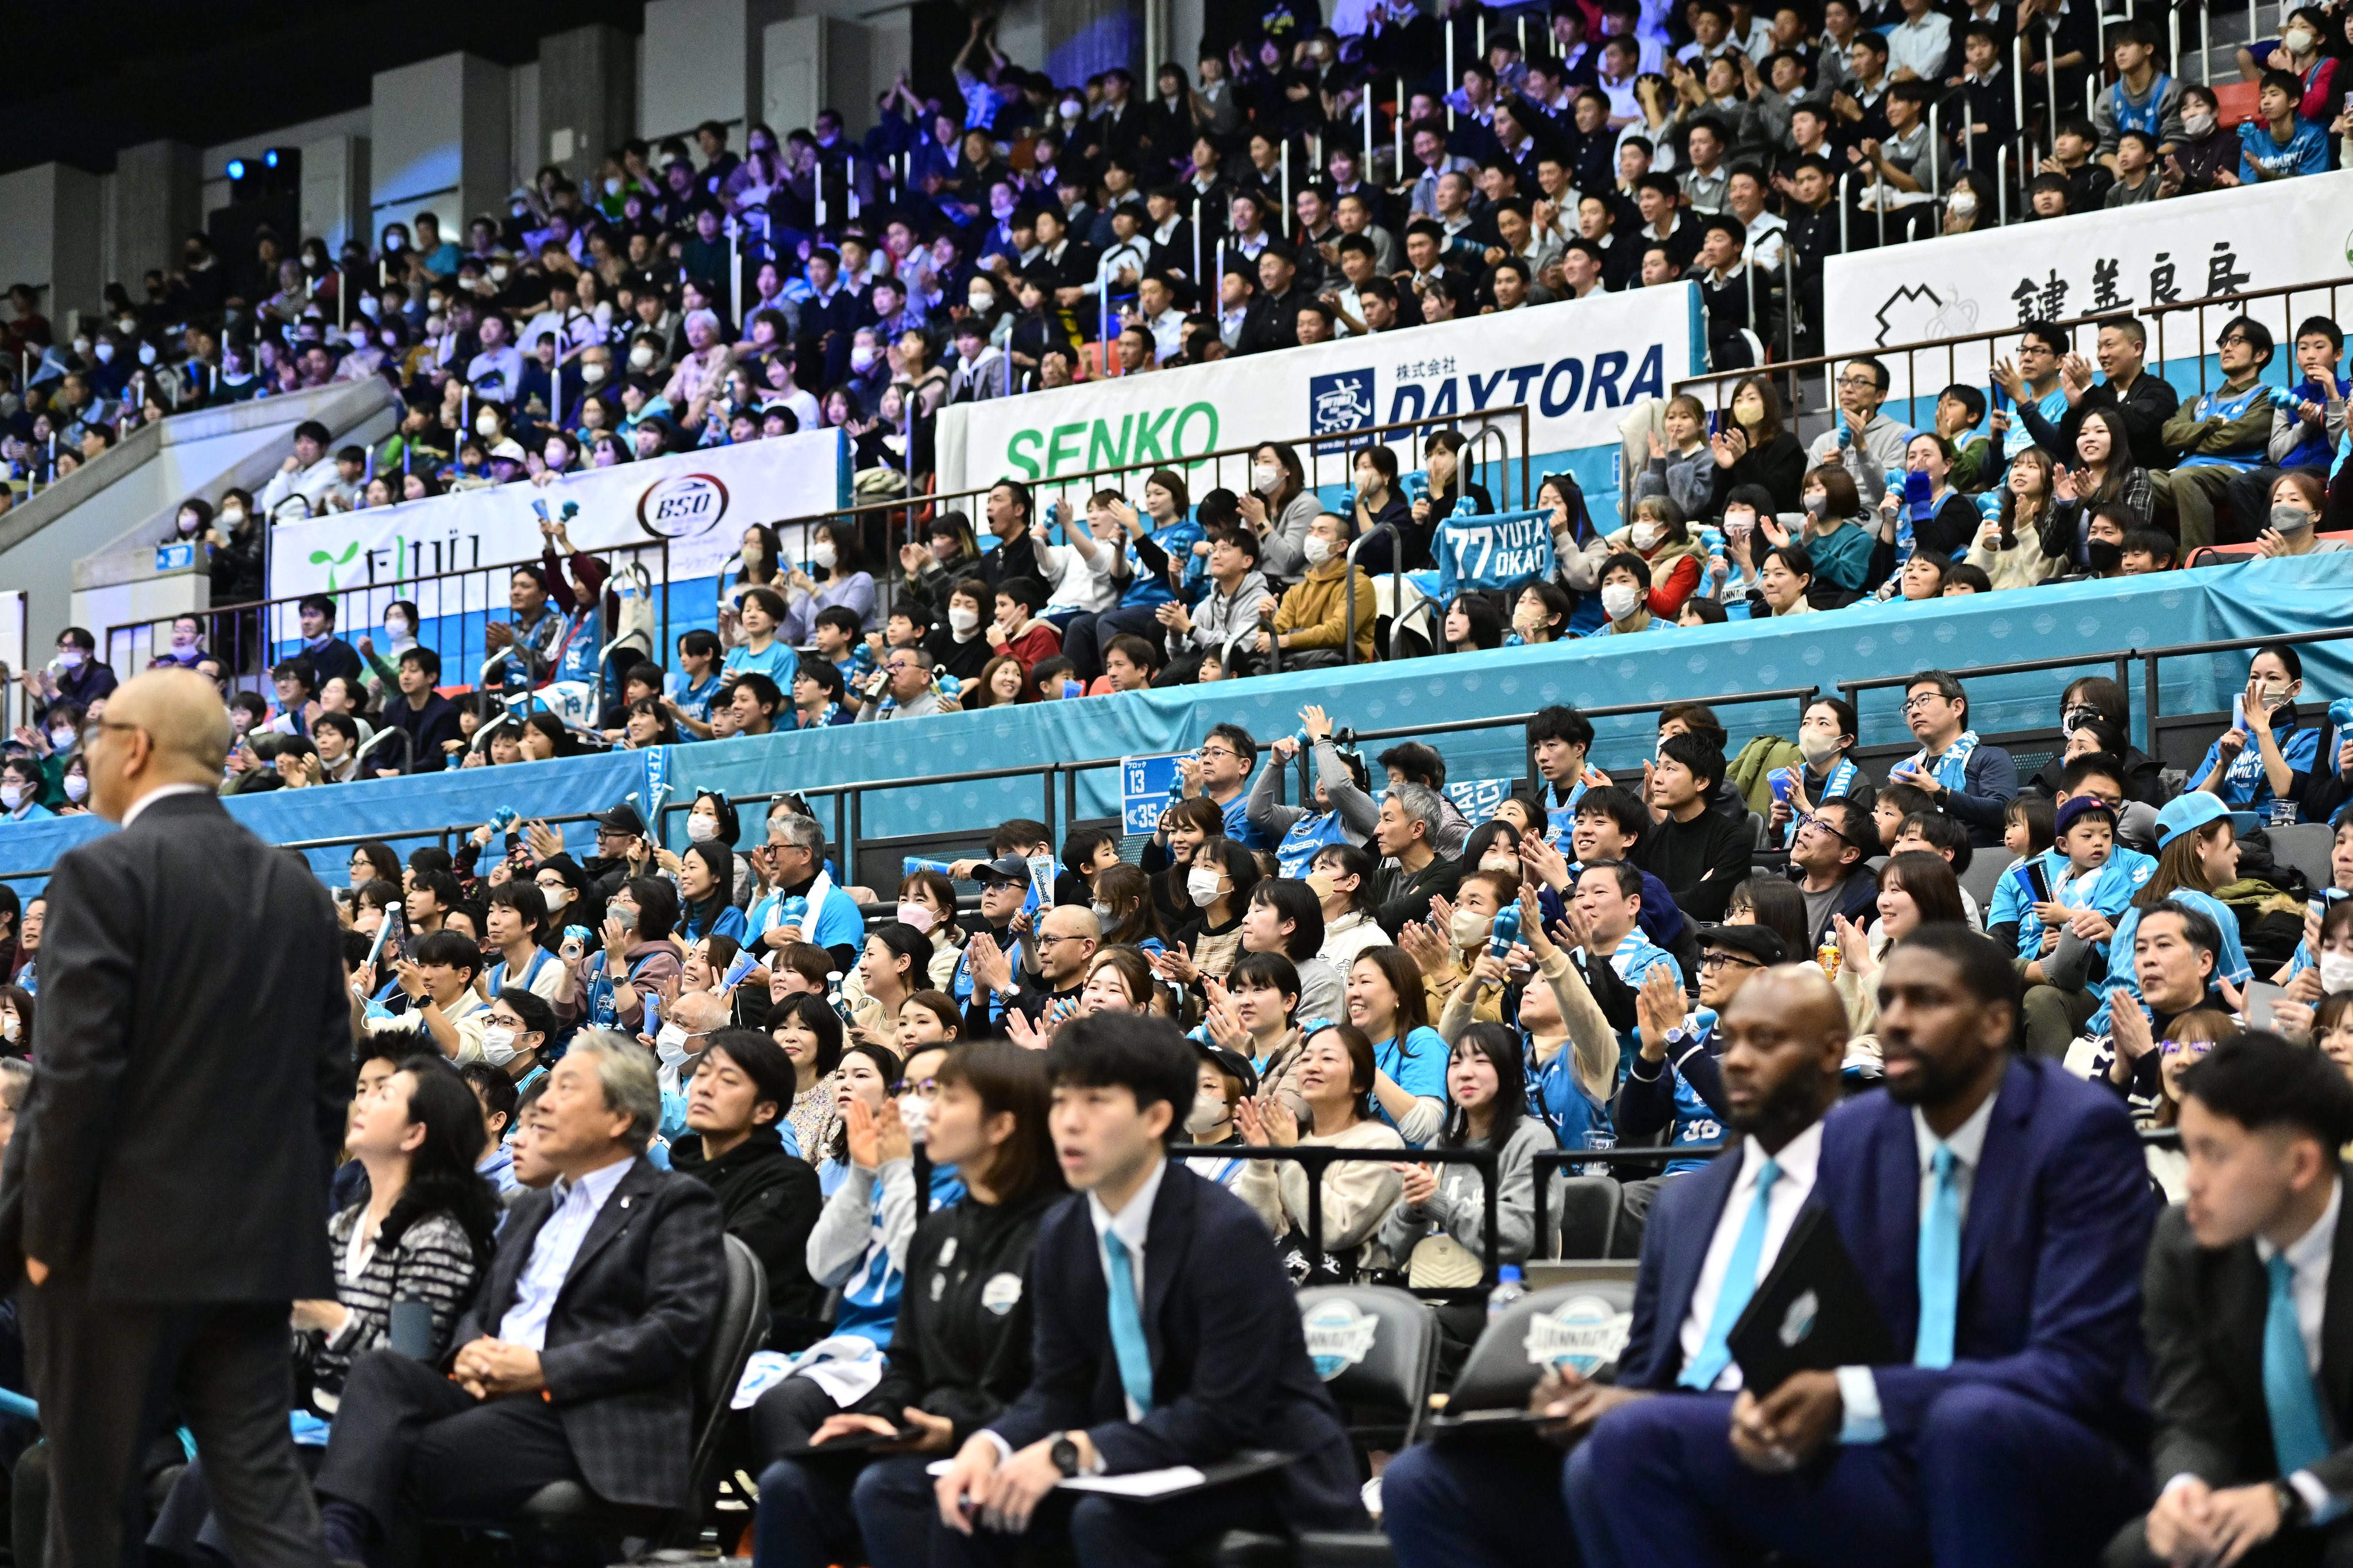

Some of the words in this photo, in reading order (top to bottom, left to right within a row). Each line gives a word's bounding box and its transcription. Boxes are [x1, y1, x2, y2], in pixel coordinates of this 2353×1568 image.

[1397, 356, 1457, 382] 株式会社
[1385, 345, 1663, 442] DAYTORA
[1008, 402, 1218, 488] SENKO
[657, 493, 711, 520] BSO
[1445, 526, 1494, 580] 77
[1495, 517, 1546, 549] YUTA
[1128, 761, 1147, 769] ブロック
[1129, 770, 1145, 794] 13
[1137, 803, 1158, 828] 35
